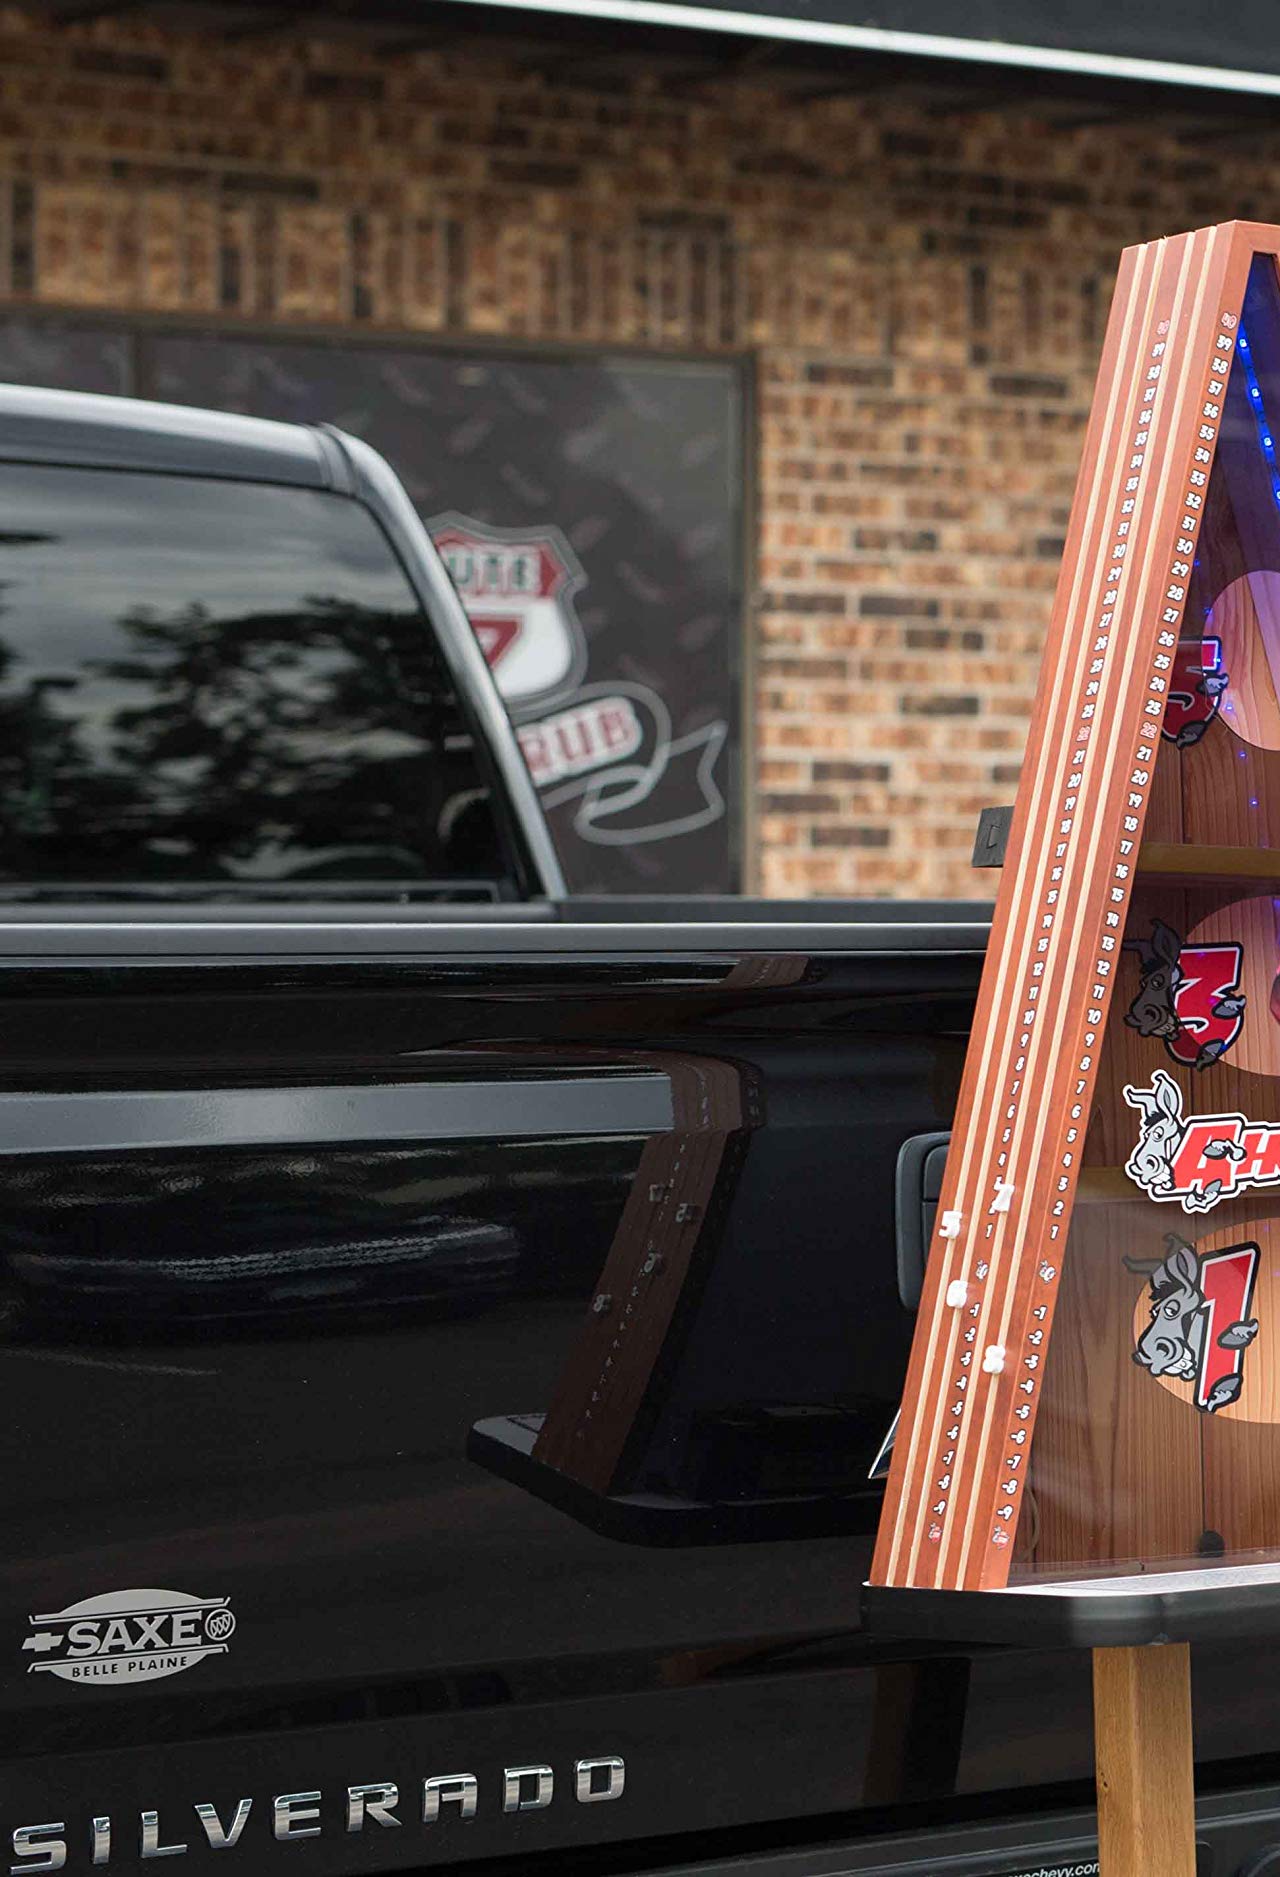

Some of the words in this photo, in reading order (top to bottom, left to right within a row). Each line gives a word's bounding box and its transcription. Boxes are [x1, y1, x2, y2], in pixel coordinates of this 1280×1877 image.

[1216, 334, 1233, 351] 39
[1211, 357, 1229, 374] 38
[1203, 402, 1219, 419] 36
[1199, 424, 1215, 441] 35
[1194, 447, 1210, 463] 34
[1190, 470, 1206, 486] 33
[1185, 492, 1202, 509] 32
[1176, 538, 1194, 555] 30
[449, 552, 530, 591] UTE
[1171, 561, 1189, 577] 29
[1167, 584, 1184, 601] 28
[469, 613, 524, 670] 7
[1158, 631, 1175, 647] 26
[1153, 654, 1171, 670] 25
[1149, 676, 1166, 692] 24
[1145, 699, 1162, 716] 23
[1140, 722, 1158, 739] 22
[517, 706, 634, 776] RUB
[1136, 746, 1152, 761] 21
[1131, 769, 1149, 786] 20
[1128, 793, 1143, 808] 19
[1124, 816, 1139, 831] 18
[1115, 864, 1129, 879] 16
[1111, 887, 1124, 902] 15
[1106, 912, 1119, 927] 14
[1101, 936, 1115, 951] 13
[1097, 960, 1110, 976] 12
[1093, 984, 1105, 999] 11
[1166, 945, 1242, 1064] 3
[1087, 1009, 1102, 1025] 10
[1085, 1033, 1095, 1047] 9
[1079, 1056, 1091, 1071] 8
[1071, 1105, 1082, 1119] 6
[1067, 1128, 1077, 1142] 5
[1063, 1153, 1072, 1167] 4
[1058, 1176, 1068, 1191] 3
[1053, 1201, 1064, 1216] 2
[1051, 1225, 1059, 1239] 1
[1199, 1250, 1257, 1406] 1
[66, 1610, 202, 1657] SAXE
[72, 1662, 119, 1678] BELLE
[127, 1656, 188, 1672] PLAINE
[9, 1755, 626, 1876] SILVERADO
